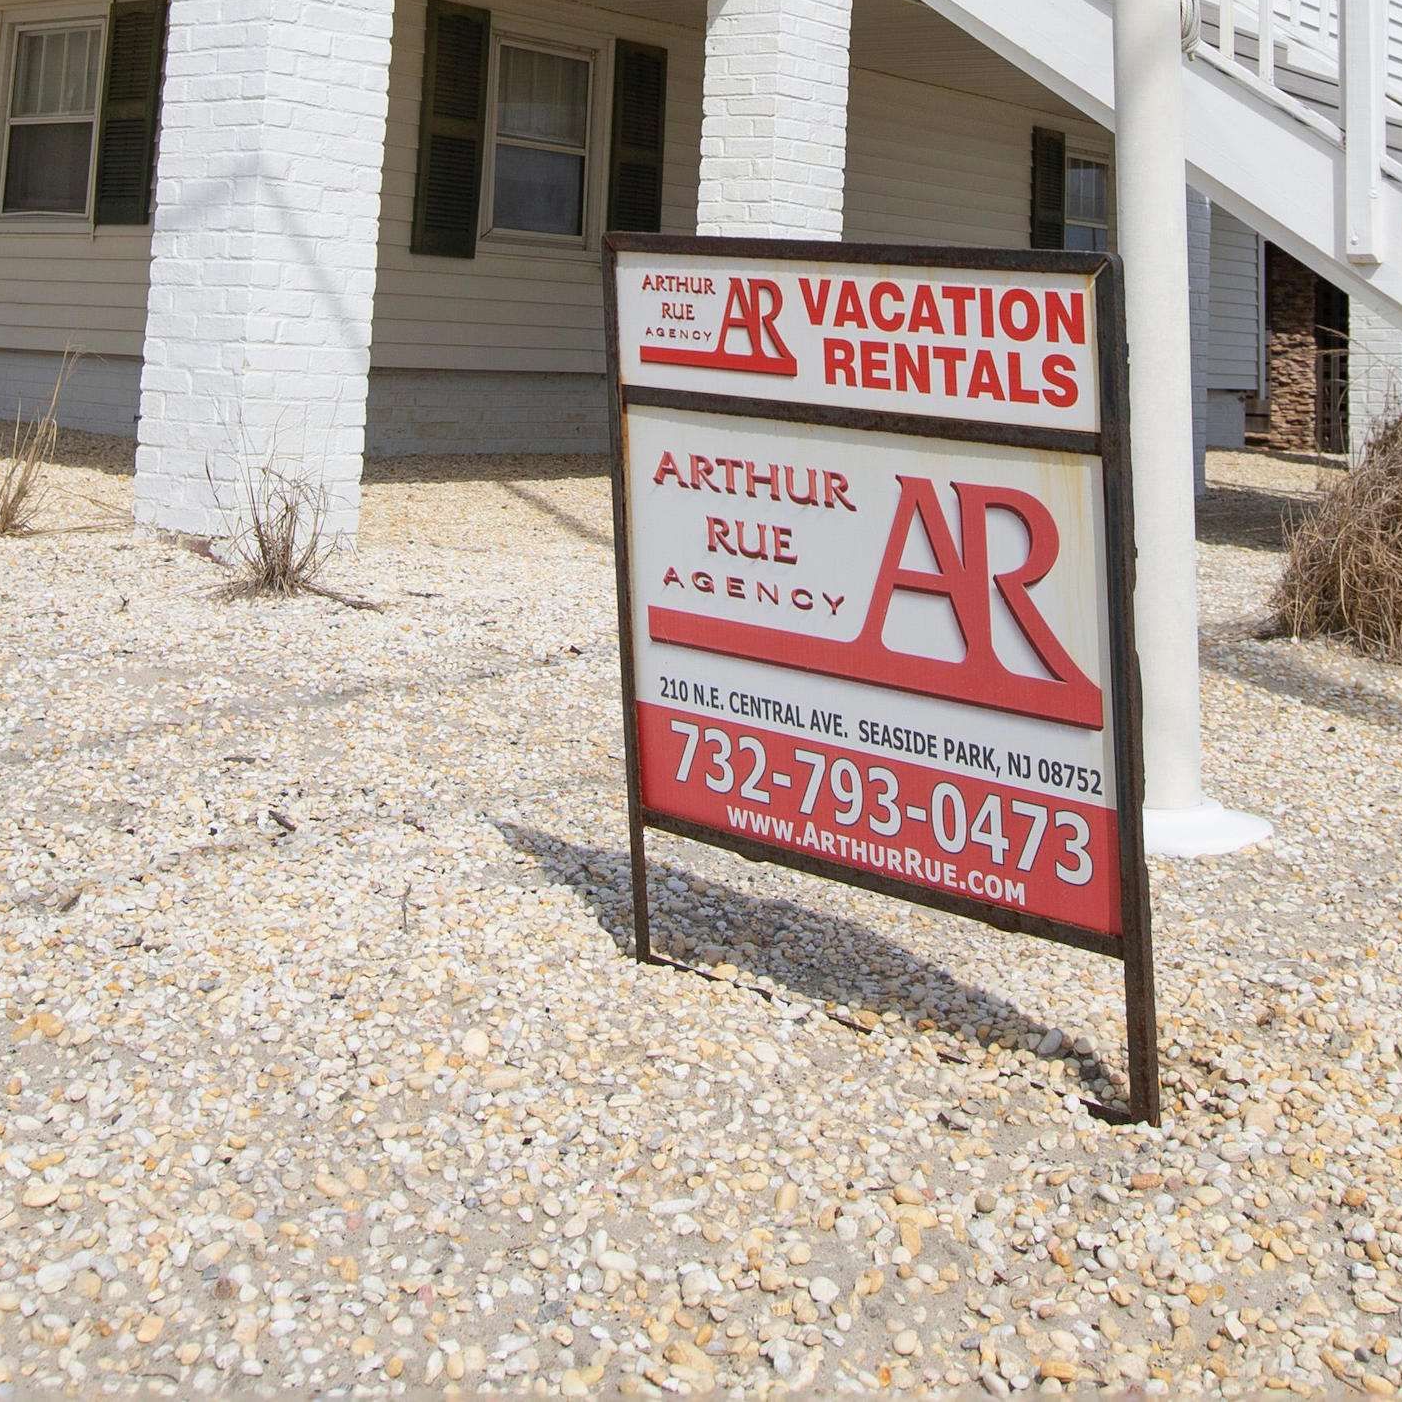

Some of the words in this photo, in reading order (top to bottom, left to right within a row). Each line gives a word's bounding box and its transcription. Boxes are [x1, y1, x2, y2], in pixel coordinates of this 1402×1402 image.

[641, 274, 716, 295] ARTHUR
[661, 302, 695, 320] RUE
[798, 278, 1086, 345] VACATION
[645, 326, 712, 341] AGENCY
[823, 337, 1079, 408] RENTALS
[653, 450, 857, 512] ARTHUR
[705, 515, 798, 565] RUE
[663, 566, 845, 616] AGENCY
[659, 676, 688, 702] 210
[693, 683, 724, 711] N.E.
[729, 691, 805, 729] CENTRAL
[810, 709, 848, 739] AVE.
[858, 719, 937, 759] SEASIDE
[944, 737, 1001, 778] PARK,
[1007, 751, 1031, 779] NJ
[1038, 758, 1103, 796] 08752
[670, 719, 1094, 887] 732-793-0473
